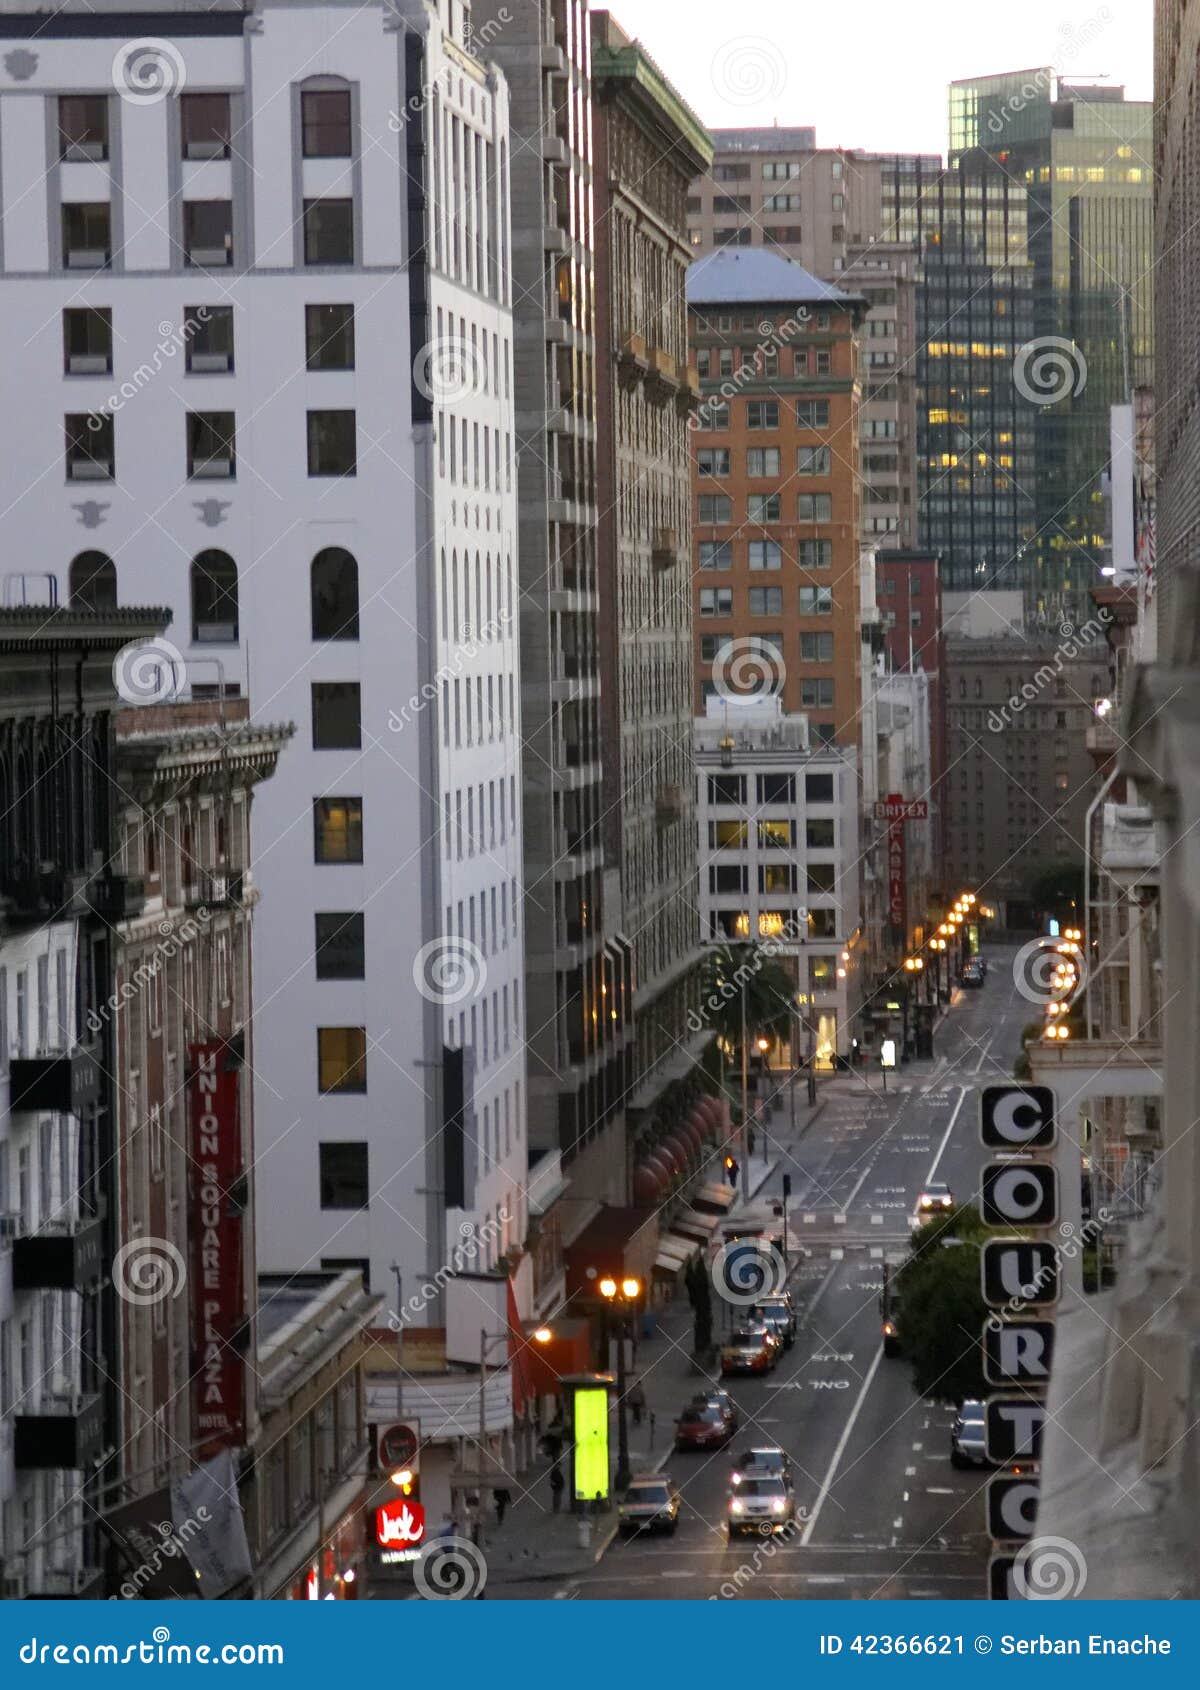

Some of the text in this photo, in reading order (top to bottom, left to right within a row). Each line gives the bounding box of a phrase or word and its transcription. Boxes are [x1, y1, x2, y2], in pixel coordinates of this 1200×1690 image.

[875, 803, 926, 817] BRITEX
[890, 822, 903, 924] FABRICS
[199, 1052, 224, 1404] UNION SQUARE PLAZA
[811, 1353, 854, 1362] BUS
[787, 1381, 850, 1390] ONLY
